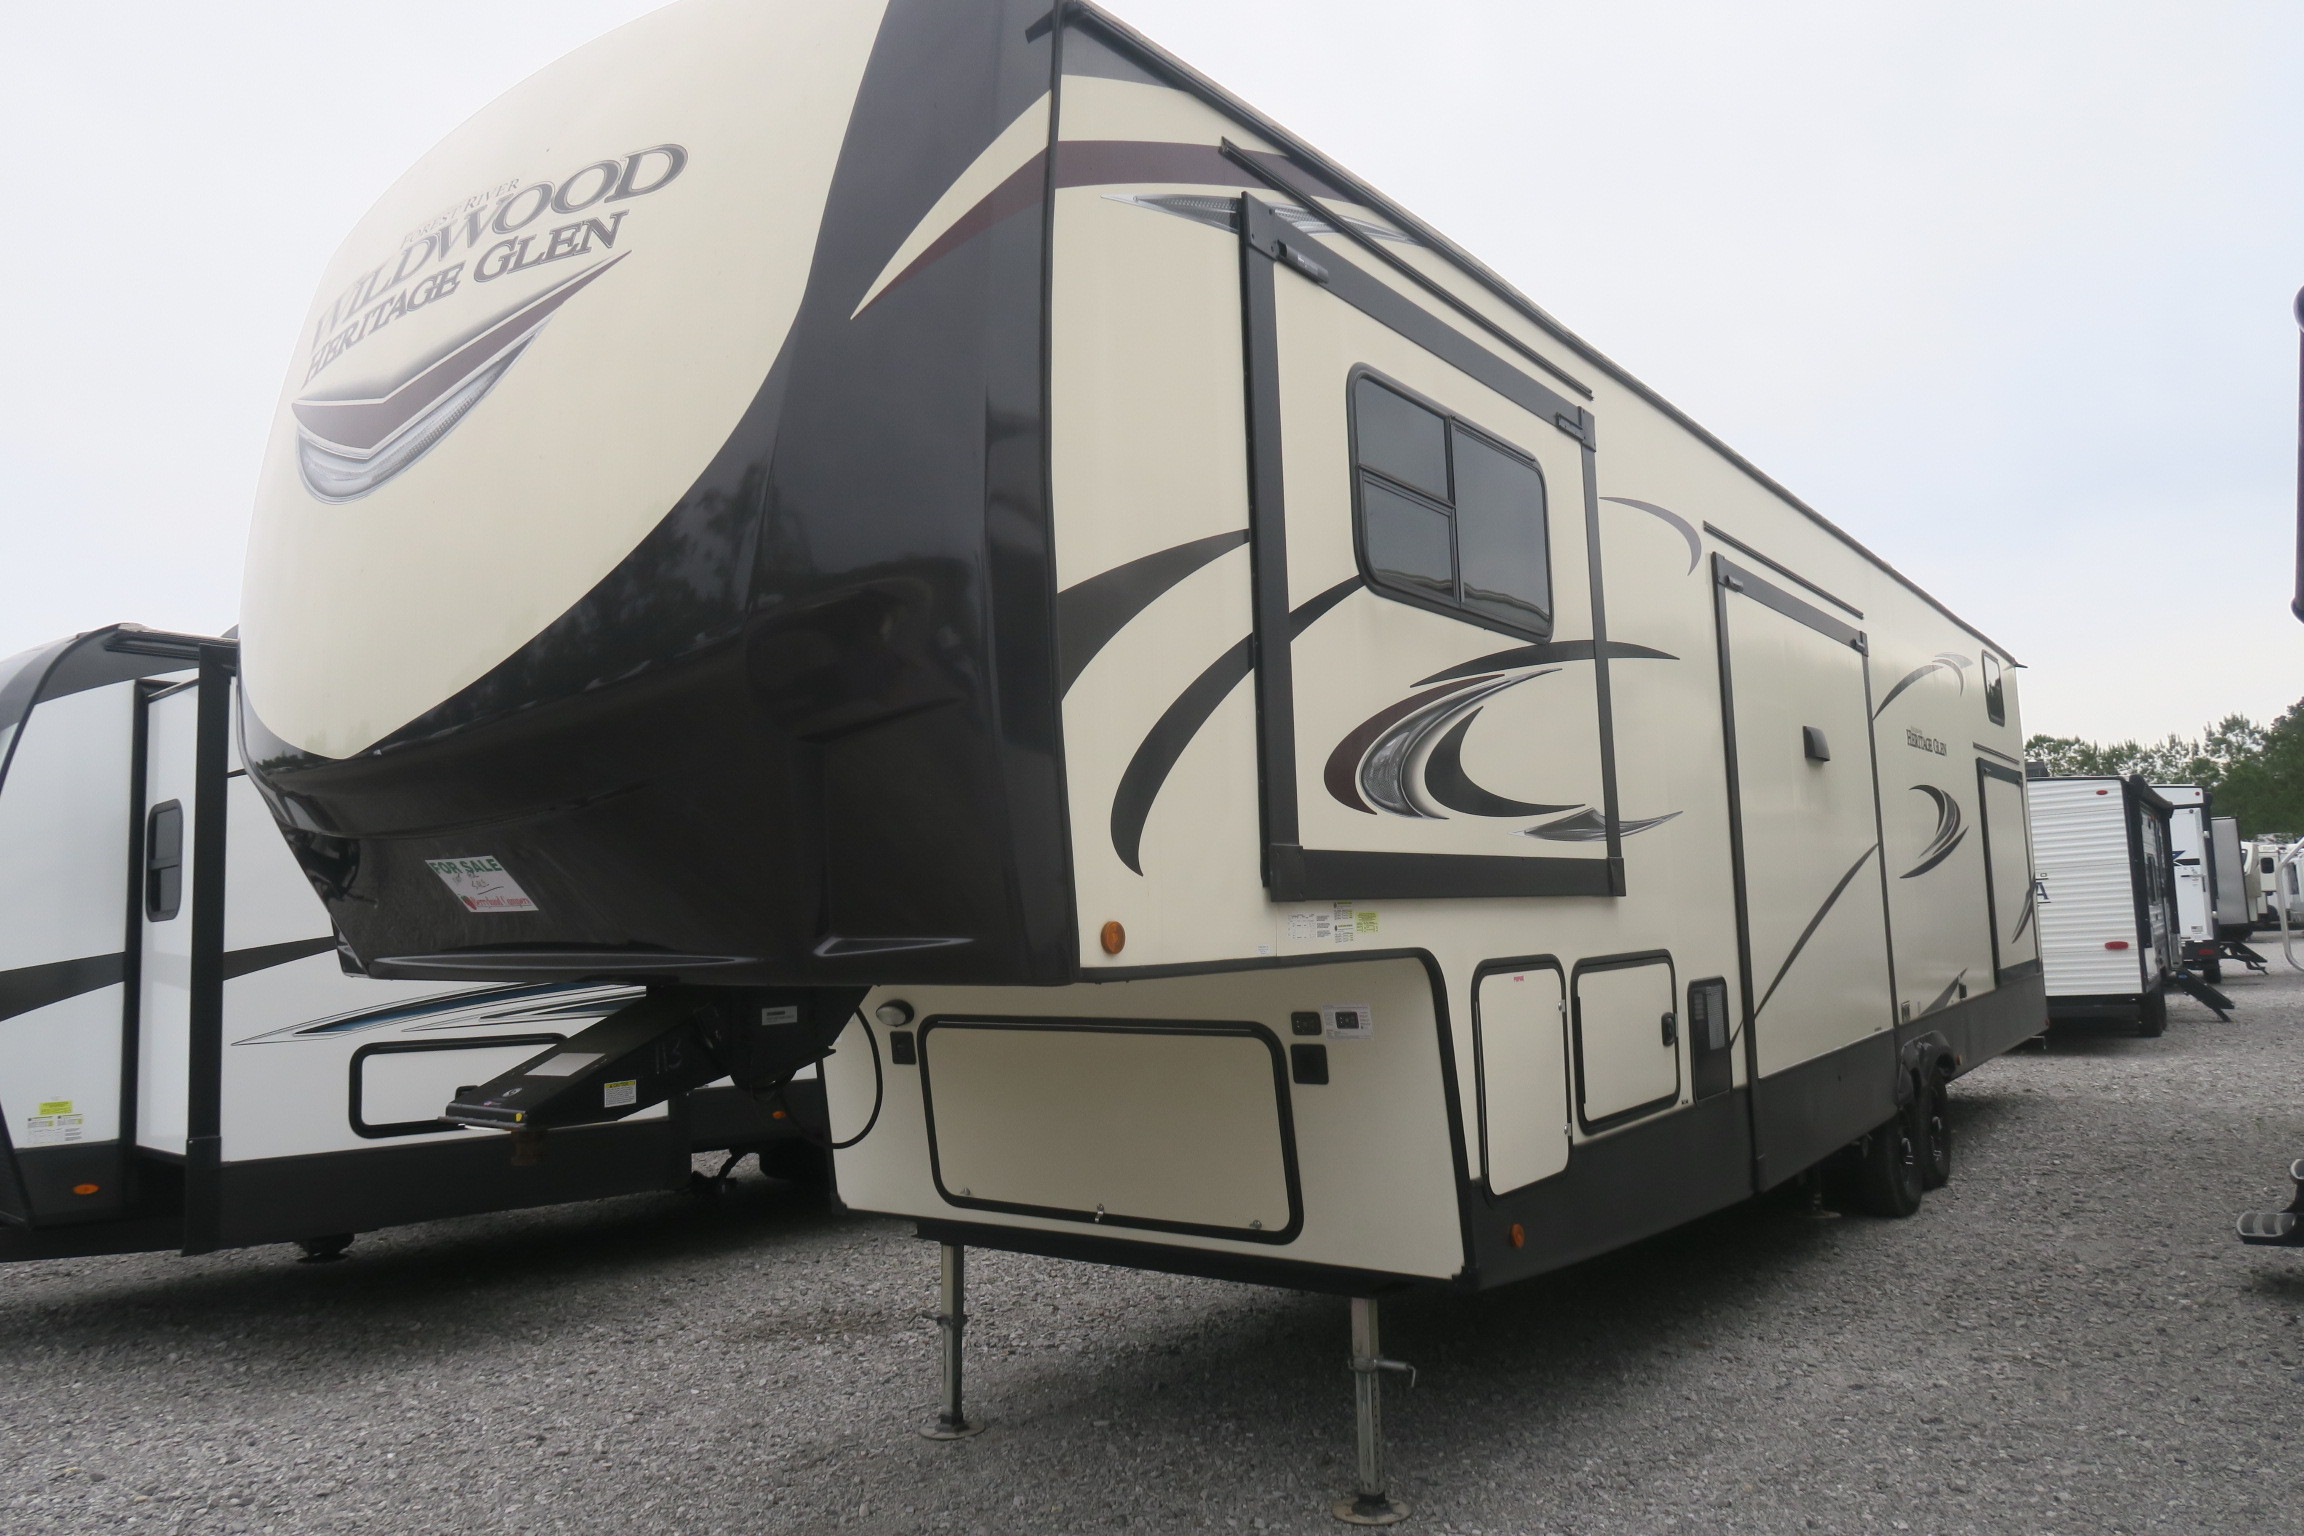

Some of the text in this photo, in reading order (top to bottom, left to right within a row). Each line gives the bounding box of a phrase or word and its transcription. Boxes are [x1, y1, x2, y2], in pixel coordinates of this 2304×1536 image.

[312, 143, 689, 352] WILDWOOD
[400, 178, 519, 249] FOREST RIVER
[301, 209, 630, 391] HERITAGE GLEN
[1906, 729, 1933, 752] HERITAGE
[429, 858, 503, 874] FOR SALE
